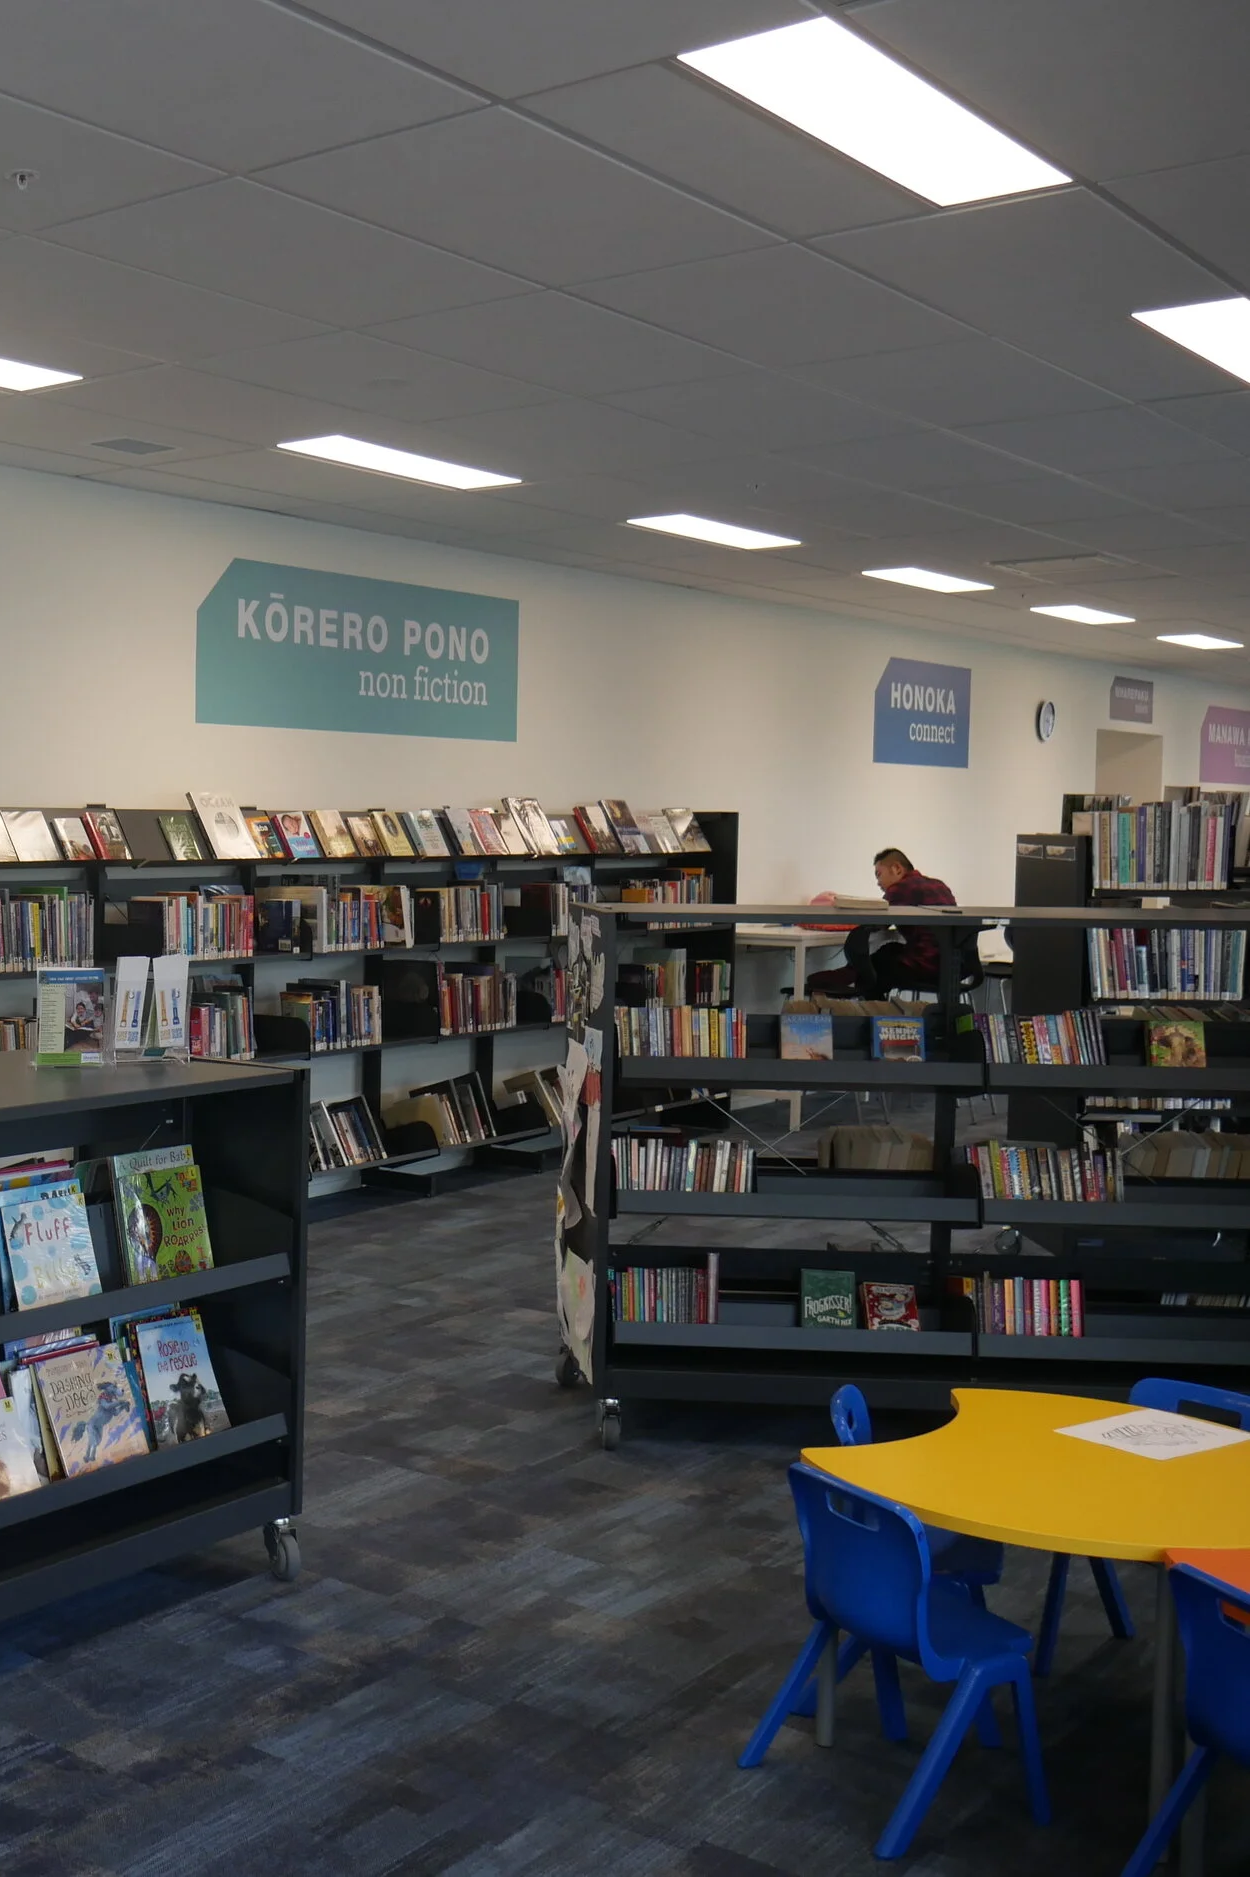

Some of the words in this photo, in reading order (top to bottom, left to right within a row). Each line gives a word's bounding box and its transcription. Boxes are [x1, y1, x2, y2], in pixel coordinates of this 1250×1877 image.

[237, 592, 388, 653] KŌRERO
[404, 619, 489, 664] PONO
[359, 670, 407, 699] non
[414, 665, 488, 706] fiction
[891, 682, 956, 714] HONOKA
[909, 722, 955, 745] connect
[1209, 723, 1245, 746] MANAWA
[129, 1155, 153, 1172] Quilt
[155, 1153, 167, 1165] for
[24, 1216, 72, 1246] Fluff
[804, 1292, 853, 1319] FROGKISSER!
[817, 1315, 840, 1325] GARTH
[157, 1340, 180, 1358] Rosie
[181, 1340, 190, 1353] to
[157, 1360, 169, 1373] the
[169, 1352, 197, 1372] rescue
